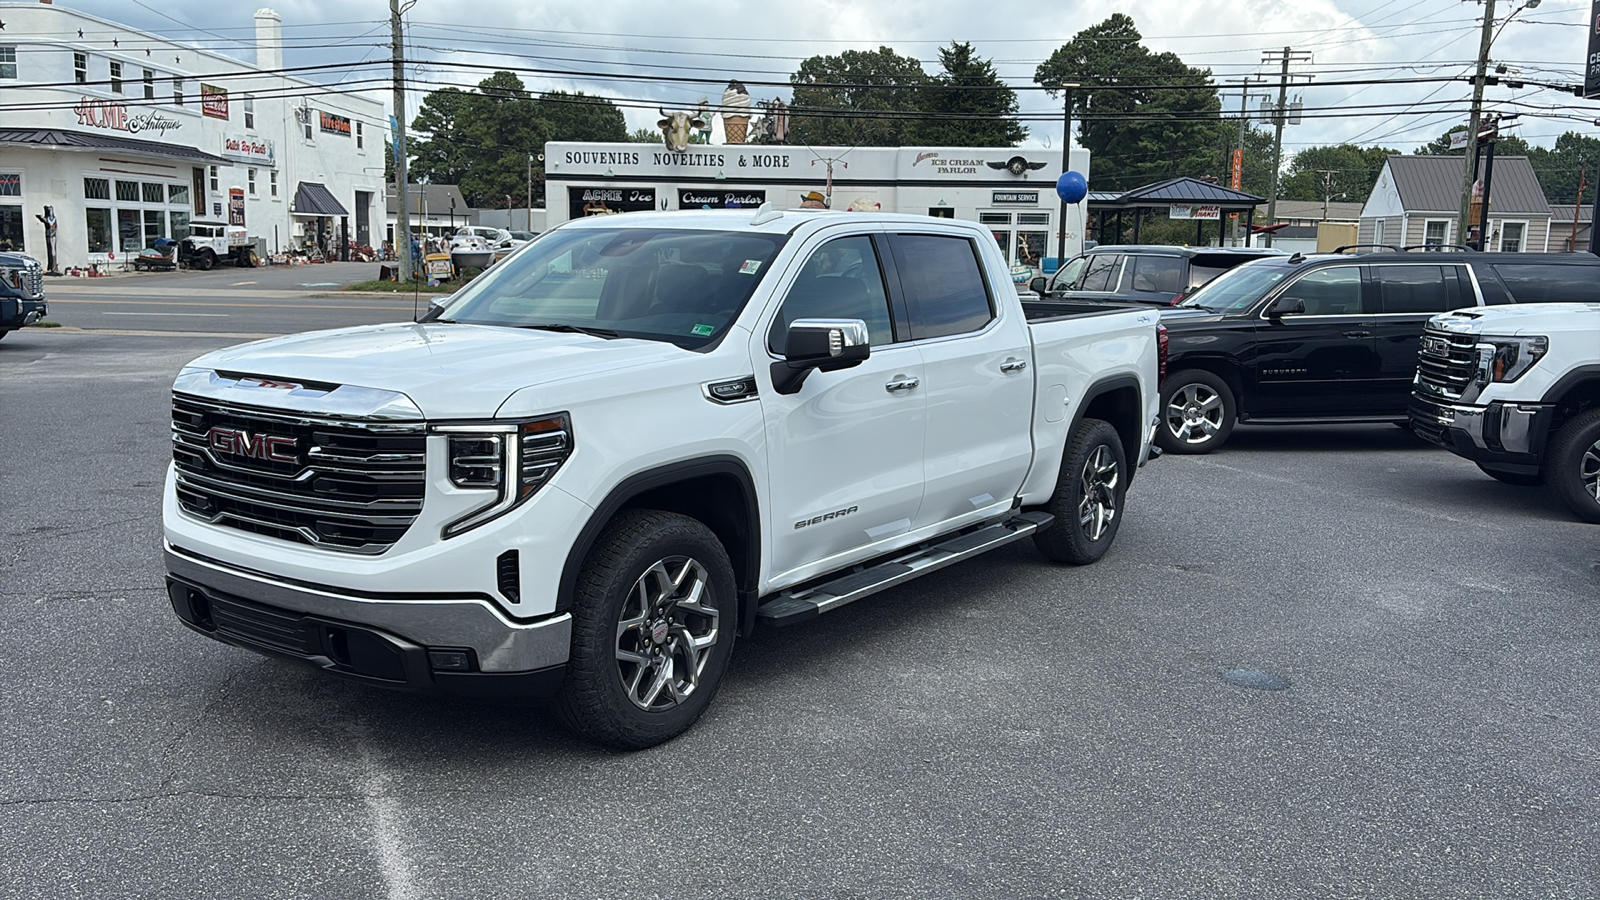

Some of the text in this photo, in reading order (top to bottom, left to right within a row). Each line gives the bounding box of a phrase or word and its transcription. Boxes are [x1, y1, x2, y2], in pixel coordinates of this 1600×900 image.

[74, 96, 129, 131] ACME
[138, 109, 182, 137] Antiques
[320, 112, 350, 132] Firestone
[241, 140, 251, 155] Boy
[251, 142, 266, 155] Paints
[565, 151, 790, 168] SOUVENIRS NOVELTIES & MORE
[931, 159, 984, 167] ICE CREAM
[582, 189, 654, 203] ACME Ice
[682, 191, 763, 205] Cream Parlor
[994, 193, 1037, 201] FOUNTAIN SERVICE
[232, 213, 244, 224] TEA
[208, 427, 300, 465] GMC
[793, 505, 859, 530] SIERRA
